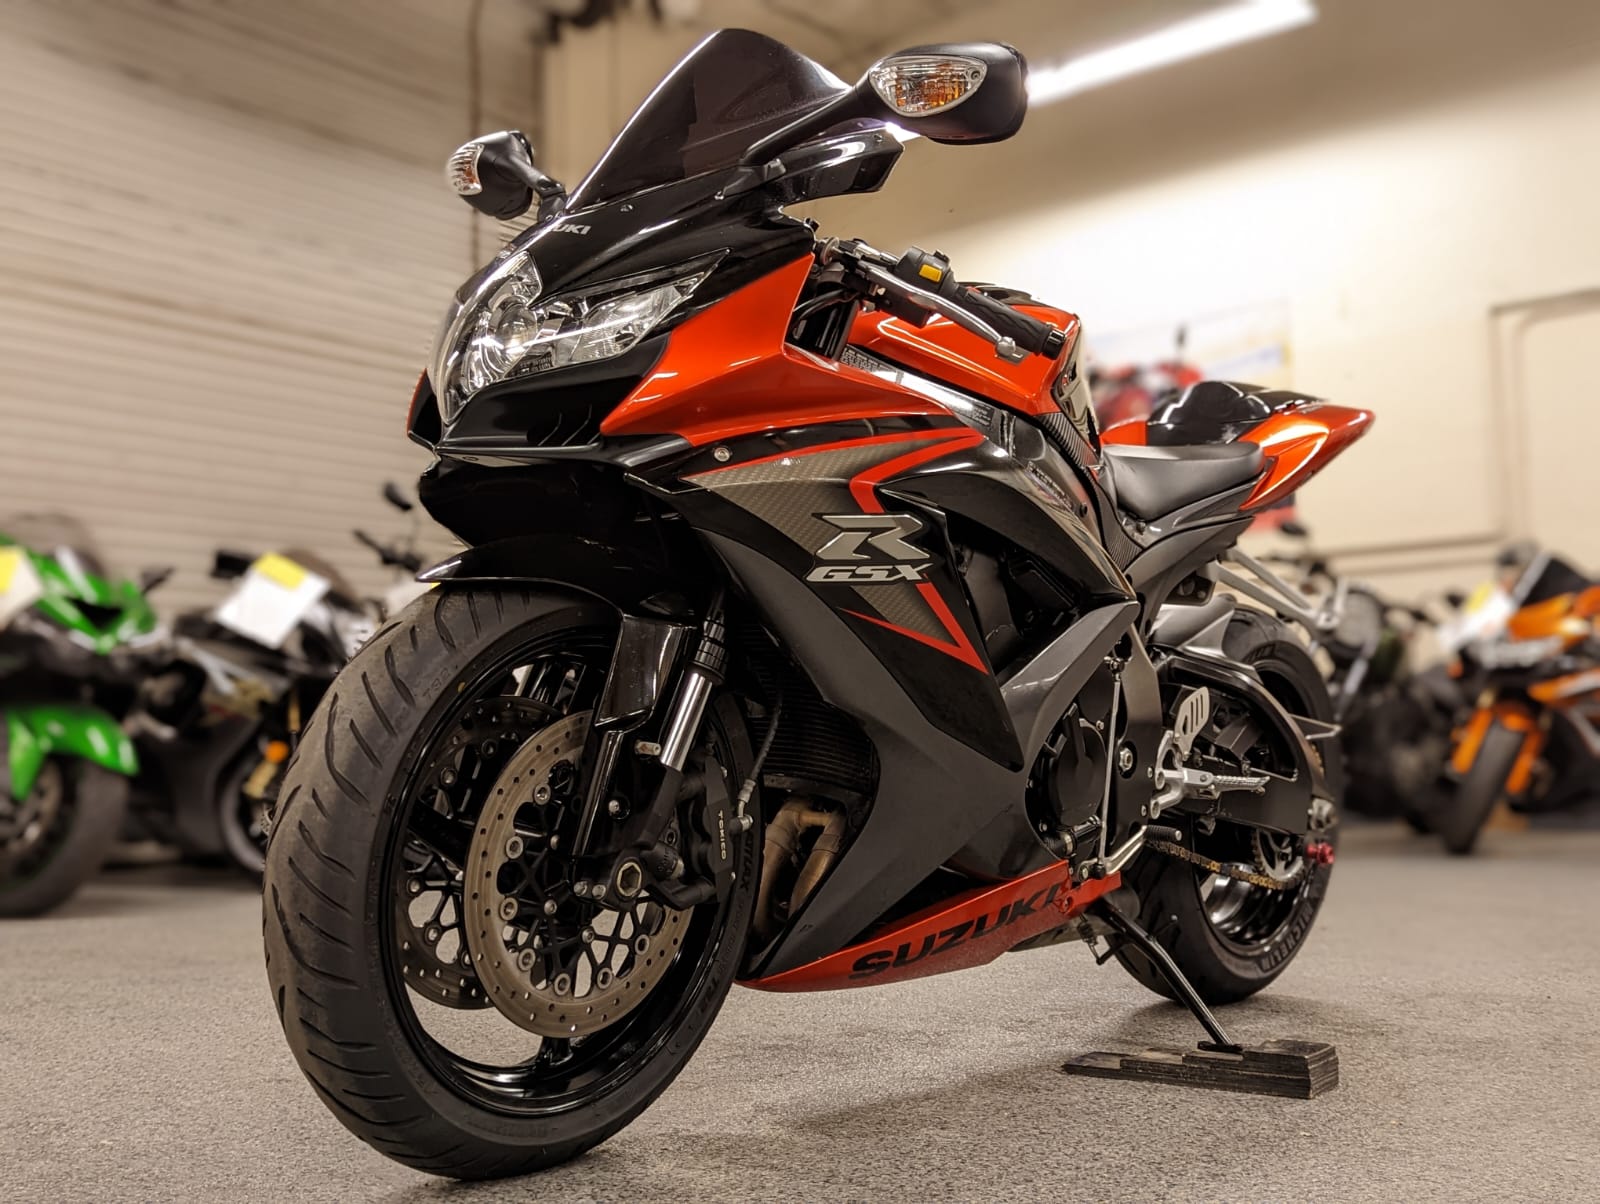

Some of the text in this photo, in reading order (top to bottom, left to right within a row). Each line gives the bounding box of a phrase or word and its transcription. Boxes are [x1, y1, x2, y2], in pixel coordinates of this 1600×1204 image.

[552, 224, 592, 235] UKI
[816, 514, 930, 560] R
[806, 563, 933, 582] GSX
[718, 809, 727, 860] TOKICO
[848, 881, 1061, 979] SUZUKI
